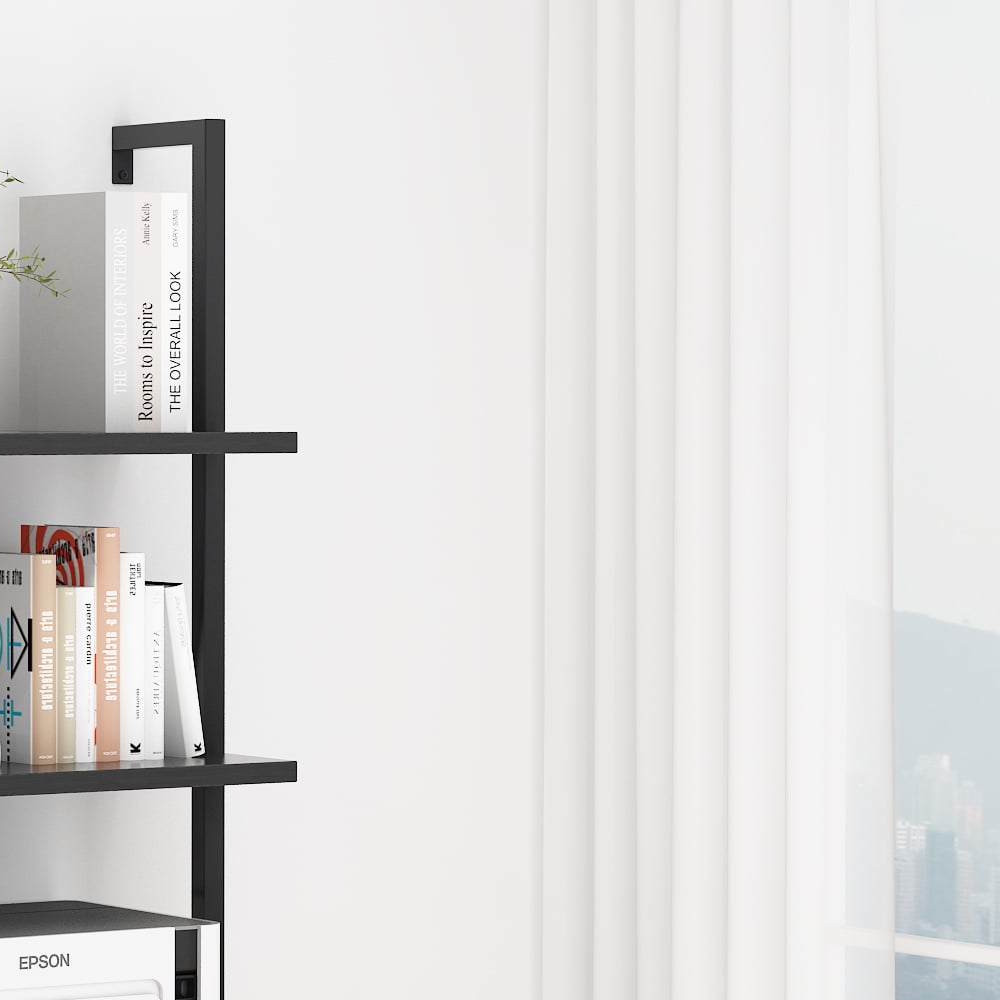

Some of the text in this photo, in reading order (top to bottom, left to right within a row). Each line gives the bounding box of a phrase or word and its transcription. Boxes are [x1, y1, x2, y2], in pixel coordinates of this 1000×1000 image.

[142, 202, 151, 245] Annie Kelly
[138, 302, 157, 421] Rooms to Inspire
[169, 271, 180, 413] THE OVERALL LOOK
[19, 954, 70, 970] EPSON
